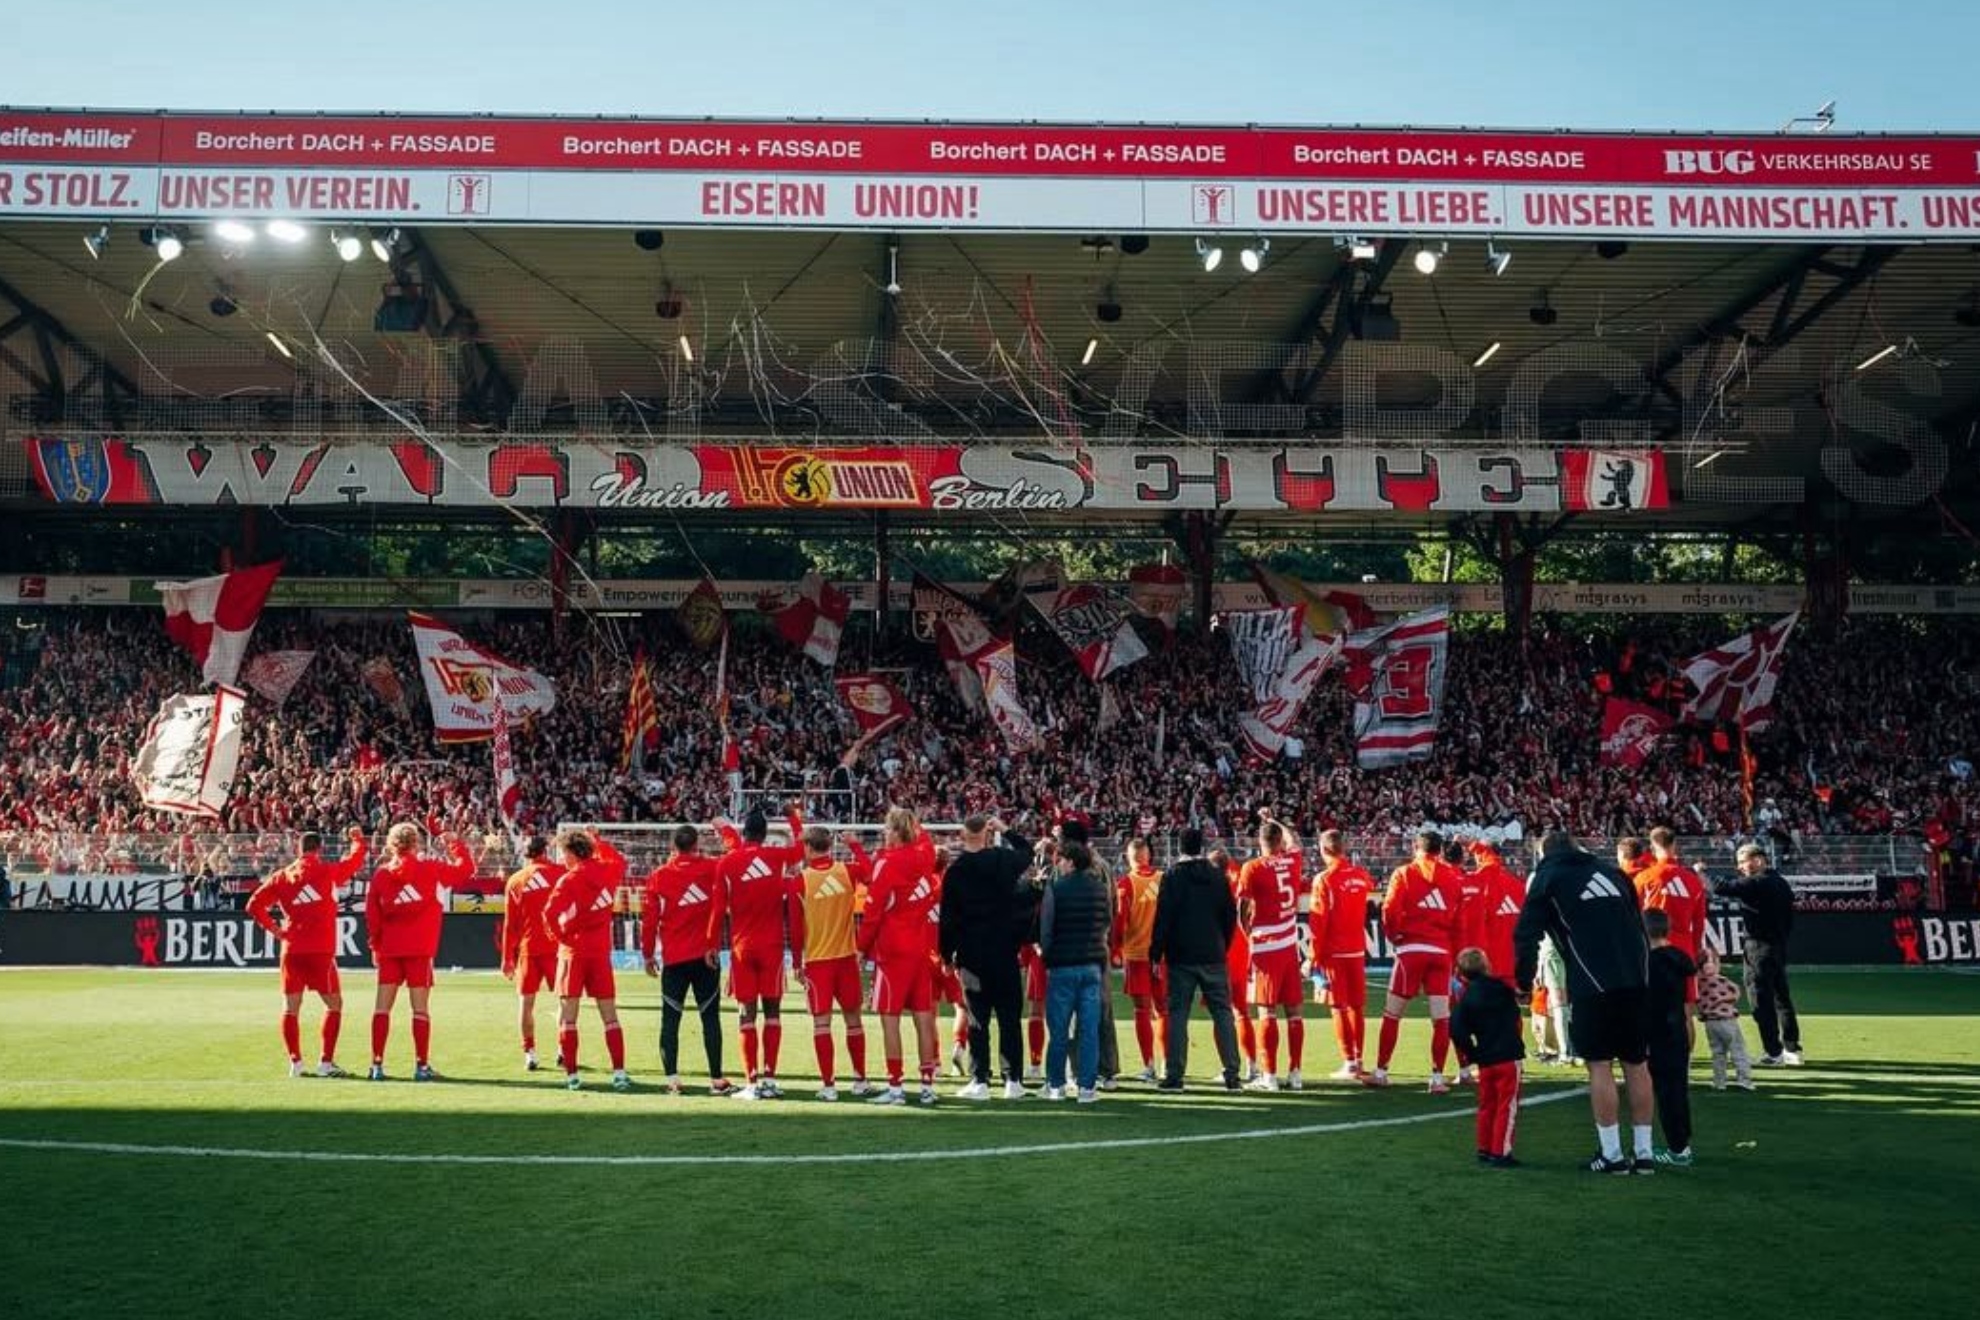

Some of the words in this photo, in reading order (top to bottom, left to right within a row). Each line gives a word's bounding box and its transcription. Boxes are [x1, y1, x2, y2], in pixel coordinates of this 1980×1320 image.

[0, 127, 132, 149] eifen-Müller
[195, 130, 295, 151] Borchert
[302, 133, 364, 152] DACH
[371, 139, 384, 151] +
[390, 134, 495, 153] FASSADE
[563, 135, 662, 155] Borchert
[668, 138, 731, 157] DACH
[738, 143, 751, 156] +
[757, 139, 862, 158] FASSADE
[930, 141, 1027, 160] Borchert
[1034, 143, 1096, 162] DACH
[1103, 148, 1115, 161] +
[1122, 144, 1226, 163] FASSADE
[1294, 145, 1390, 164] Borchert
[1397, 148, 1458, 166] DACH
[1464, 153, 1476, 166] +
[1483, 150, 1585, 168] FASSADE
[1664, 150, 1755, 174] BUG
[1761, 154, 1904, 170] VERKEHRSBAU
[1910, 154, 1931, 170] SE
[0, 173, 12, 205] R
[23, 173, 139, 208] STOLZ.
[161, 175, 274, 210] UNSER
[286, 177, 420, 211] VEREIN.
[702, 181, 825, 216] EISERN
[854, 185, 979, 218] UNION!
[1257, 190, 1388, 223] UNSERE
[1398, 192, 1501, 224] LIEBE.
[1524, 194, 1653, 227] UNSERE
[1670, 196, 1906, 228] MANNSCHAFT.
[1924, 197, 1980, 228] UNS
[592, 473, 730, 508] Union
[834, 462, 916, 502] UNION
[929, 475, 1066, 512] Berlin
[603, 587, 697, 603] Empowerin
[1275, 870, 1296, 911] 5
[164, 917, 362, 966] BERLIR
[1921, 917, 1980, 962] BE
